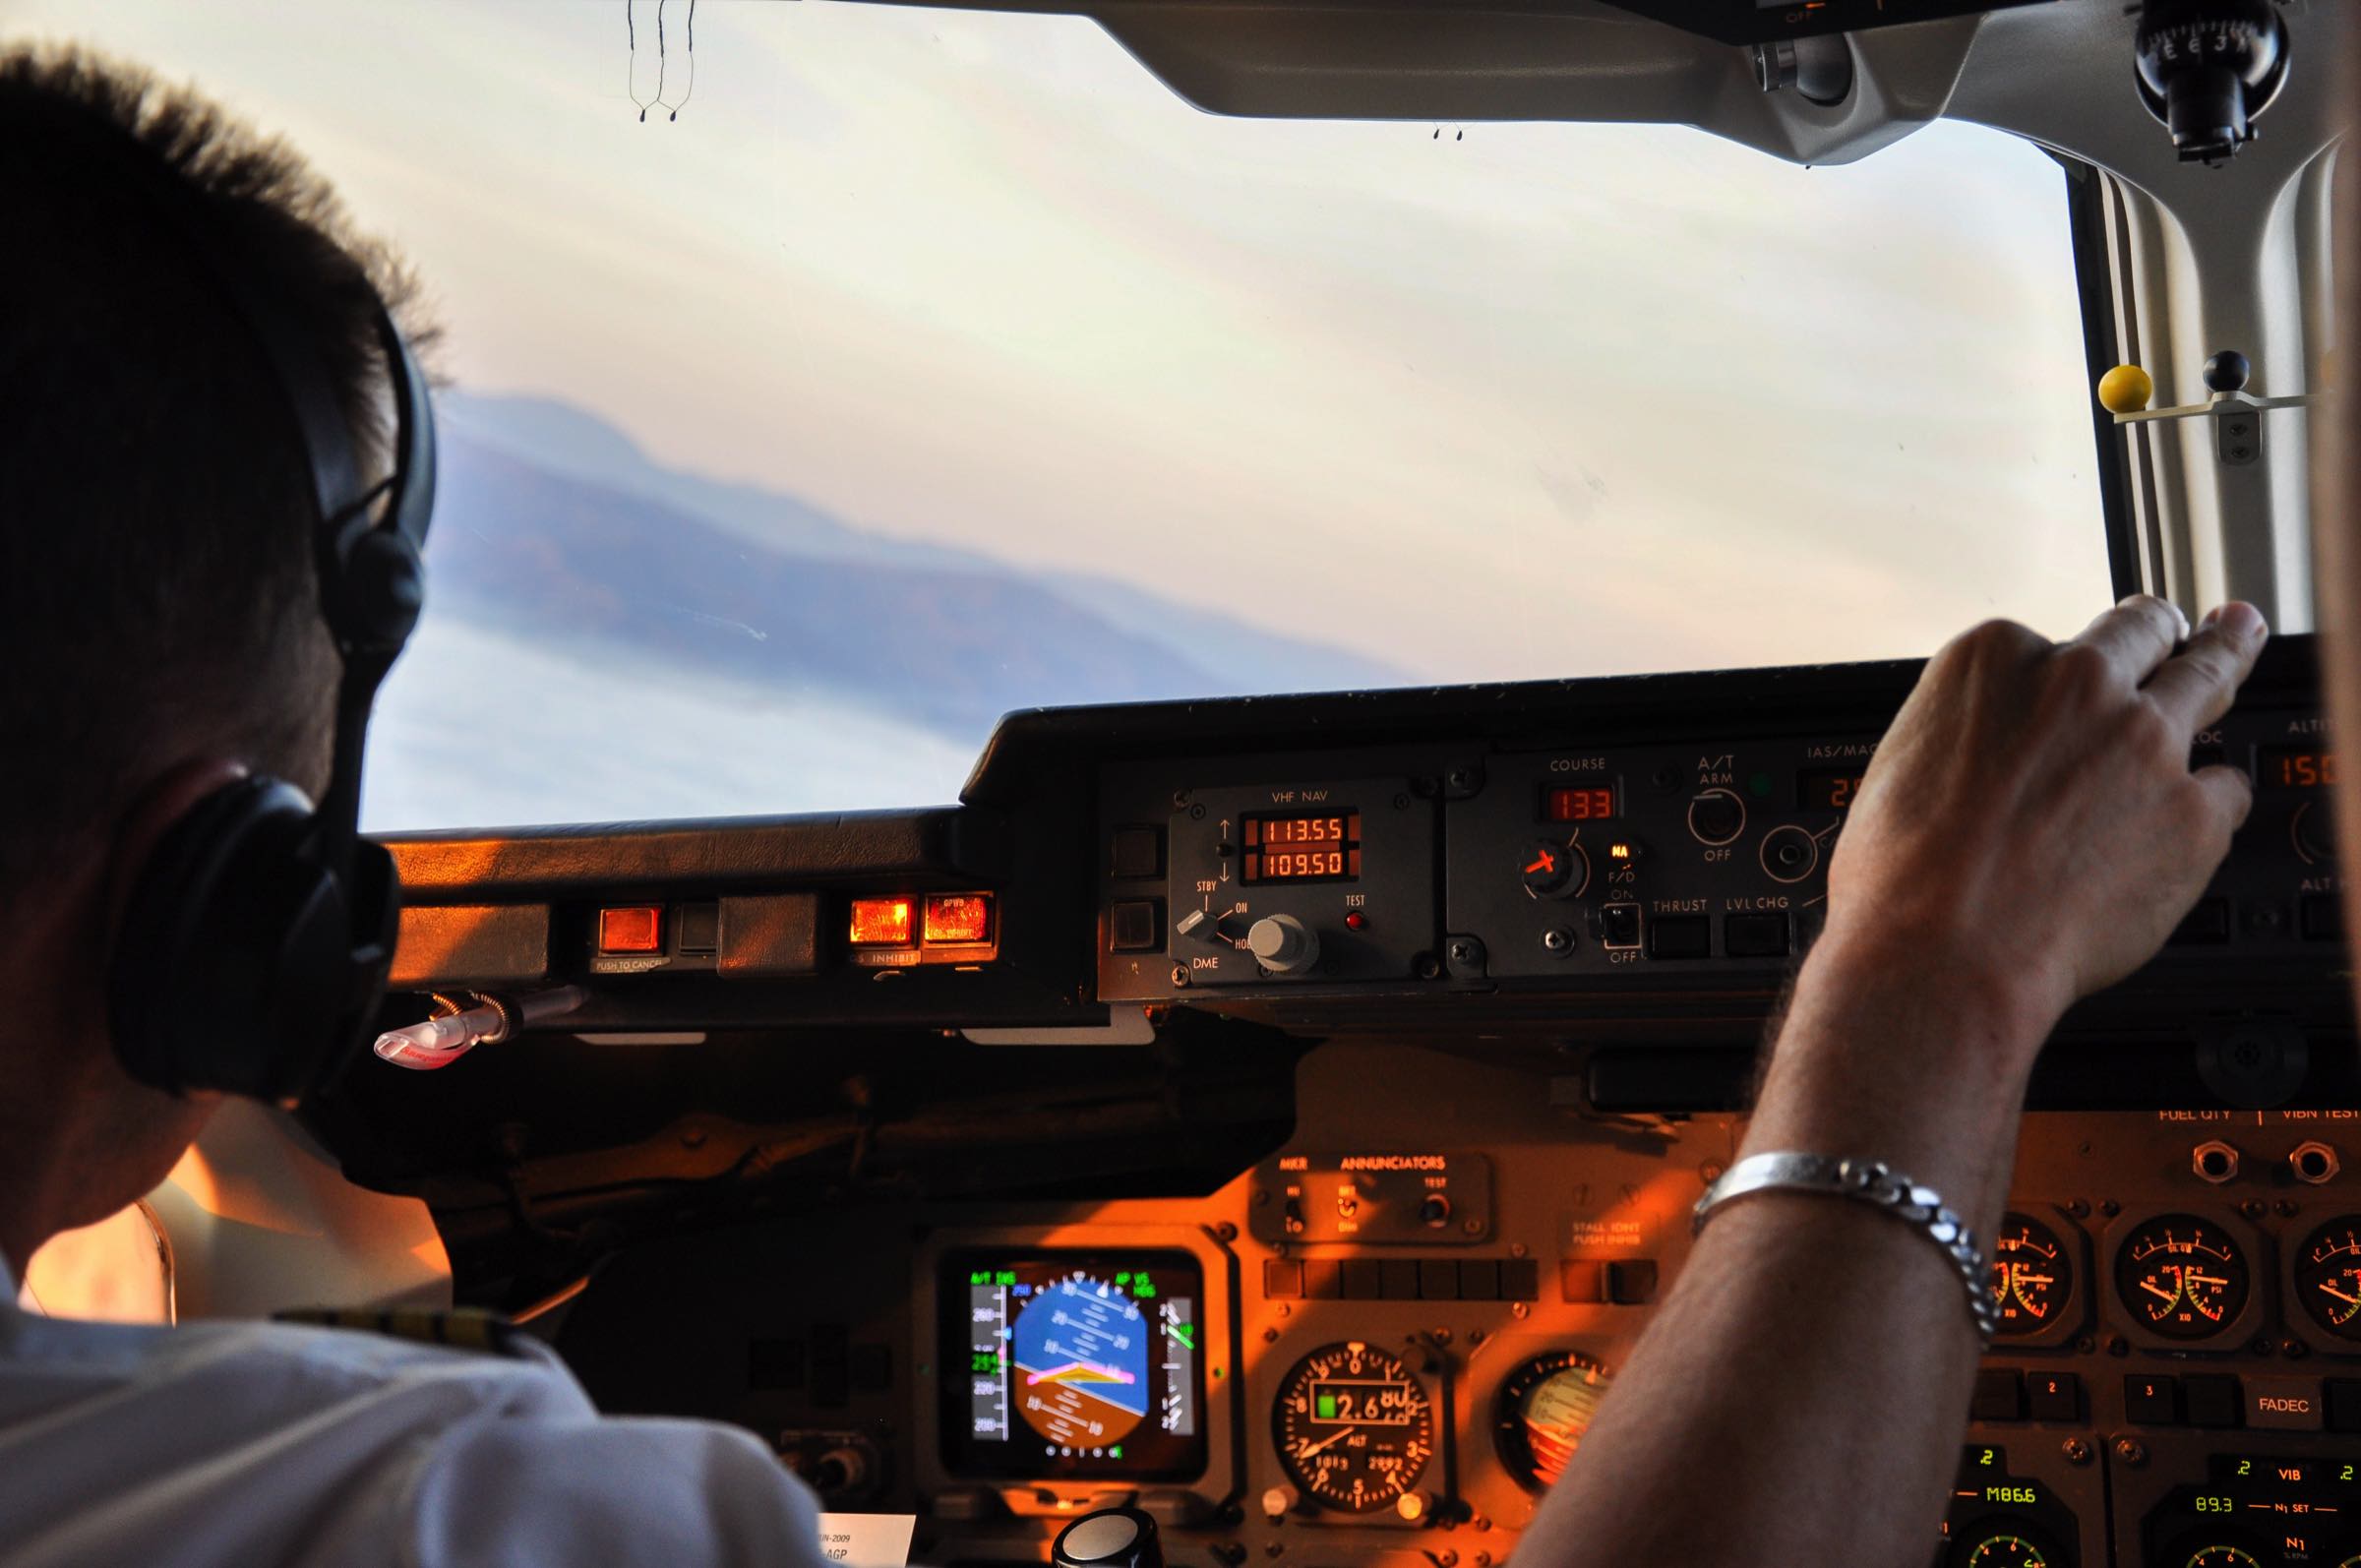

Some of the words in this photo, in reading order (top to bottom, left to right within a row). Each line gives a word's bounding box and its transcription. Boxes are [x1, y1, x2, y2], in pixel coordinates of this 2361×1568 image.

[1549, 758, 1605, 772] COURSE
[1698, 755, 1733, 770] A/T
[1699, 773, 1732, 784] ARM
[1272, 791, 1295, 804] VHF
[1302, 790, 1328, 802] NAV
[1561, 791, 1610, 818] 133
[1269, 818, 1342, 842] 113.55
[1704, 849, 1731, 862] OFF
[1269, 852, 1342, 875] 109.50
[1608, 872, 1635, 883] F/D
[1196, 880, 1217, 893] STBY
[1346, 894, 1364, 906] TEST
[1610, 889, 1634, 900] ON
[1236, 902, 1247, 914] ON
[1653, 900, 1708, 912] THRUST
[1725, 899, 1754, 911] LVL
[1756, 897, 1788, 909] CHG
[873, 952, 916, 964] INHIBIT
[1193, 957, 1219, 969] DME
[1610, 952, 1637, 963] OFF
[596, 960, 618, 972] PUSH
[619, 961, 631, 971] TO
[1279, 1157, 1307, 1171] MKR
[1340, 1155, 1445, 1171] ANNUNCIATORS
[2179, 1313, 2192, 1322] X10
[1349, 1359, 1362, 1375] 0
[2259, 1397, 2309, 1414] FADEC
[1406, 1441, 1418, 1458] 3
[2278, 1469, 2301, 1481] VIB
[1353, 1478, 1364, 1494] 5
[2196, 1496, 2232, 1512] 89.3
[2274, 1503, 2287, 1515] N1
[2292, 1504, 2309, 1514] SET
[2286, 1537, 2305, 1551] N1
